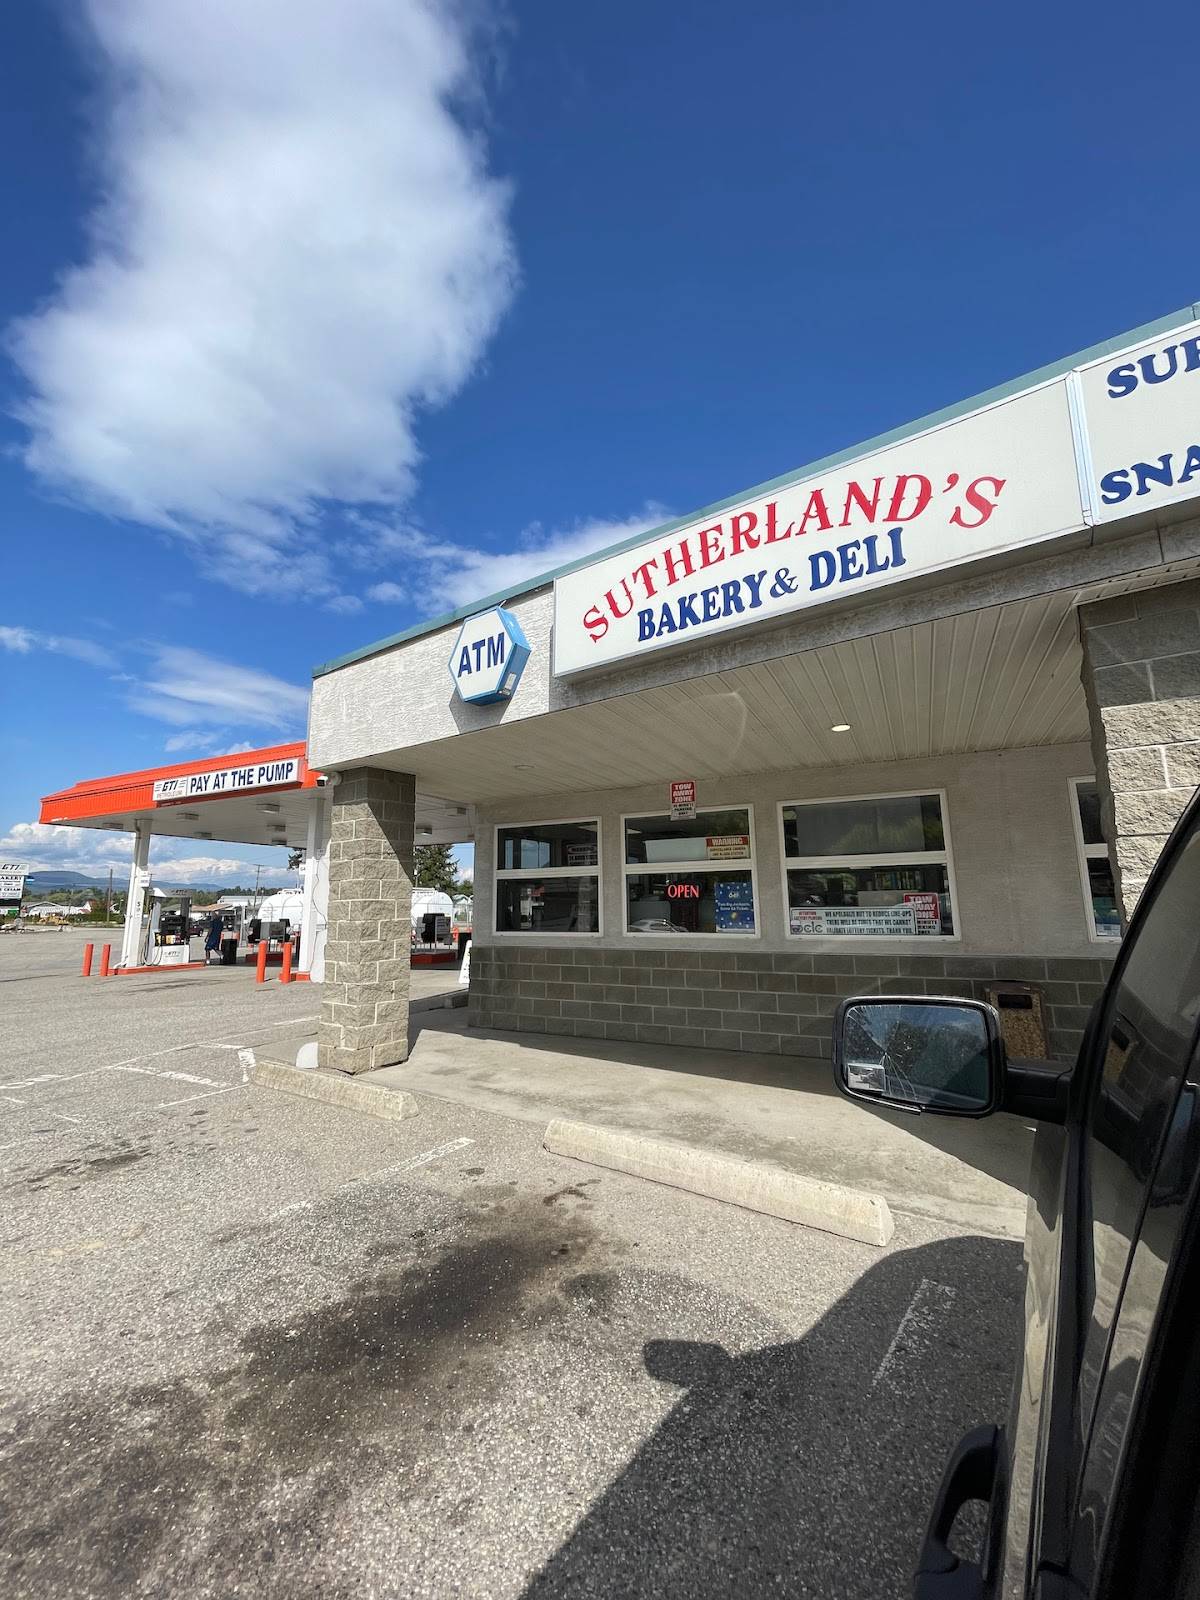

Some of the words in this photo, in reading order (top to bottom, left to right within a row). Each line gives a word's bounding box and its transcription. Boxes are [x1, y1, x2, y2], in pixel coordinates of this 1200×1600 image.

[583, 472, 1007, 643] SUTHERLAND'S
[637, 569, 767, 642] BAKERY
[769, 567, 799, 599] &
[808, 527, 906, 591] DELI
[457, 632, 505, 678] ATM
[190, 775, 211, 793] PAY
[213, 772, 228, 790] AT
[231, 768, 254, 787] THE
[258, 762, 294, 783] PUMP
[161, 780, 179, 792] GTI
[673, 789, 693, 797] AWAY
[711, 837, 743, 846] WARNING
[667, 884, 700, 898] OPEN
[909, 895, 933, 903] TOW
[914, 911, 936, 919] ONE
[792, 921, 823, 933] clc
